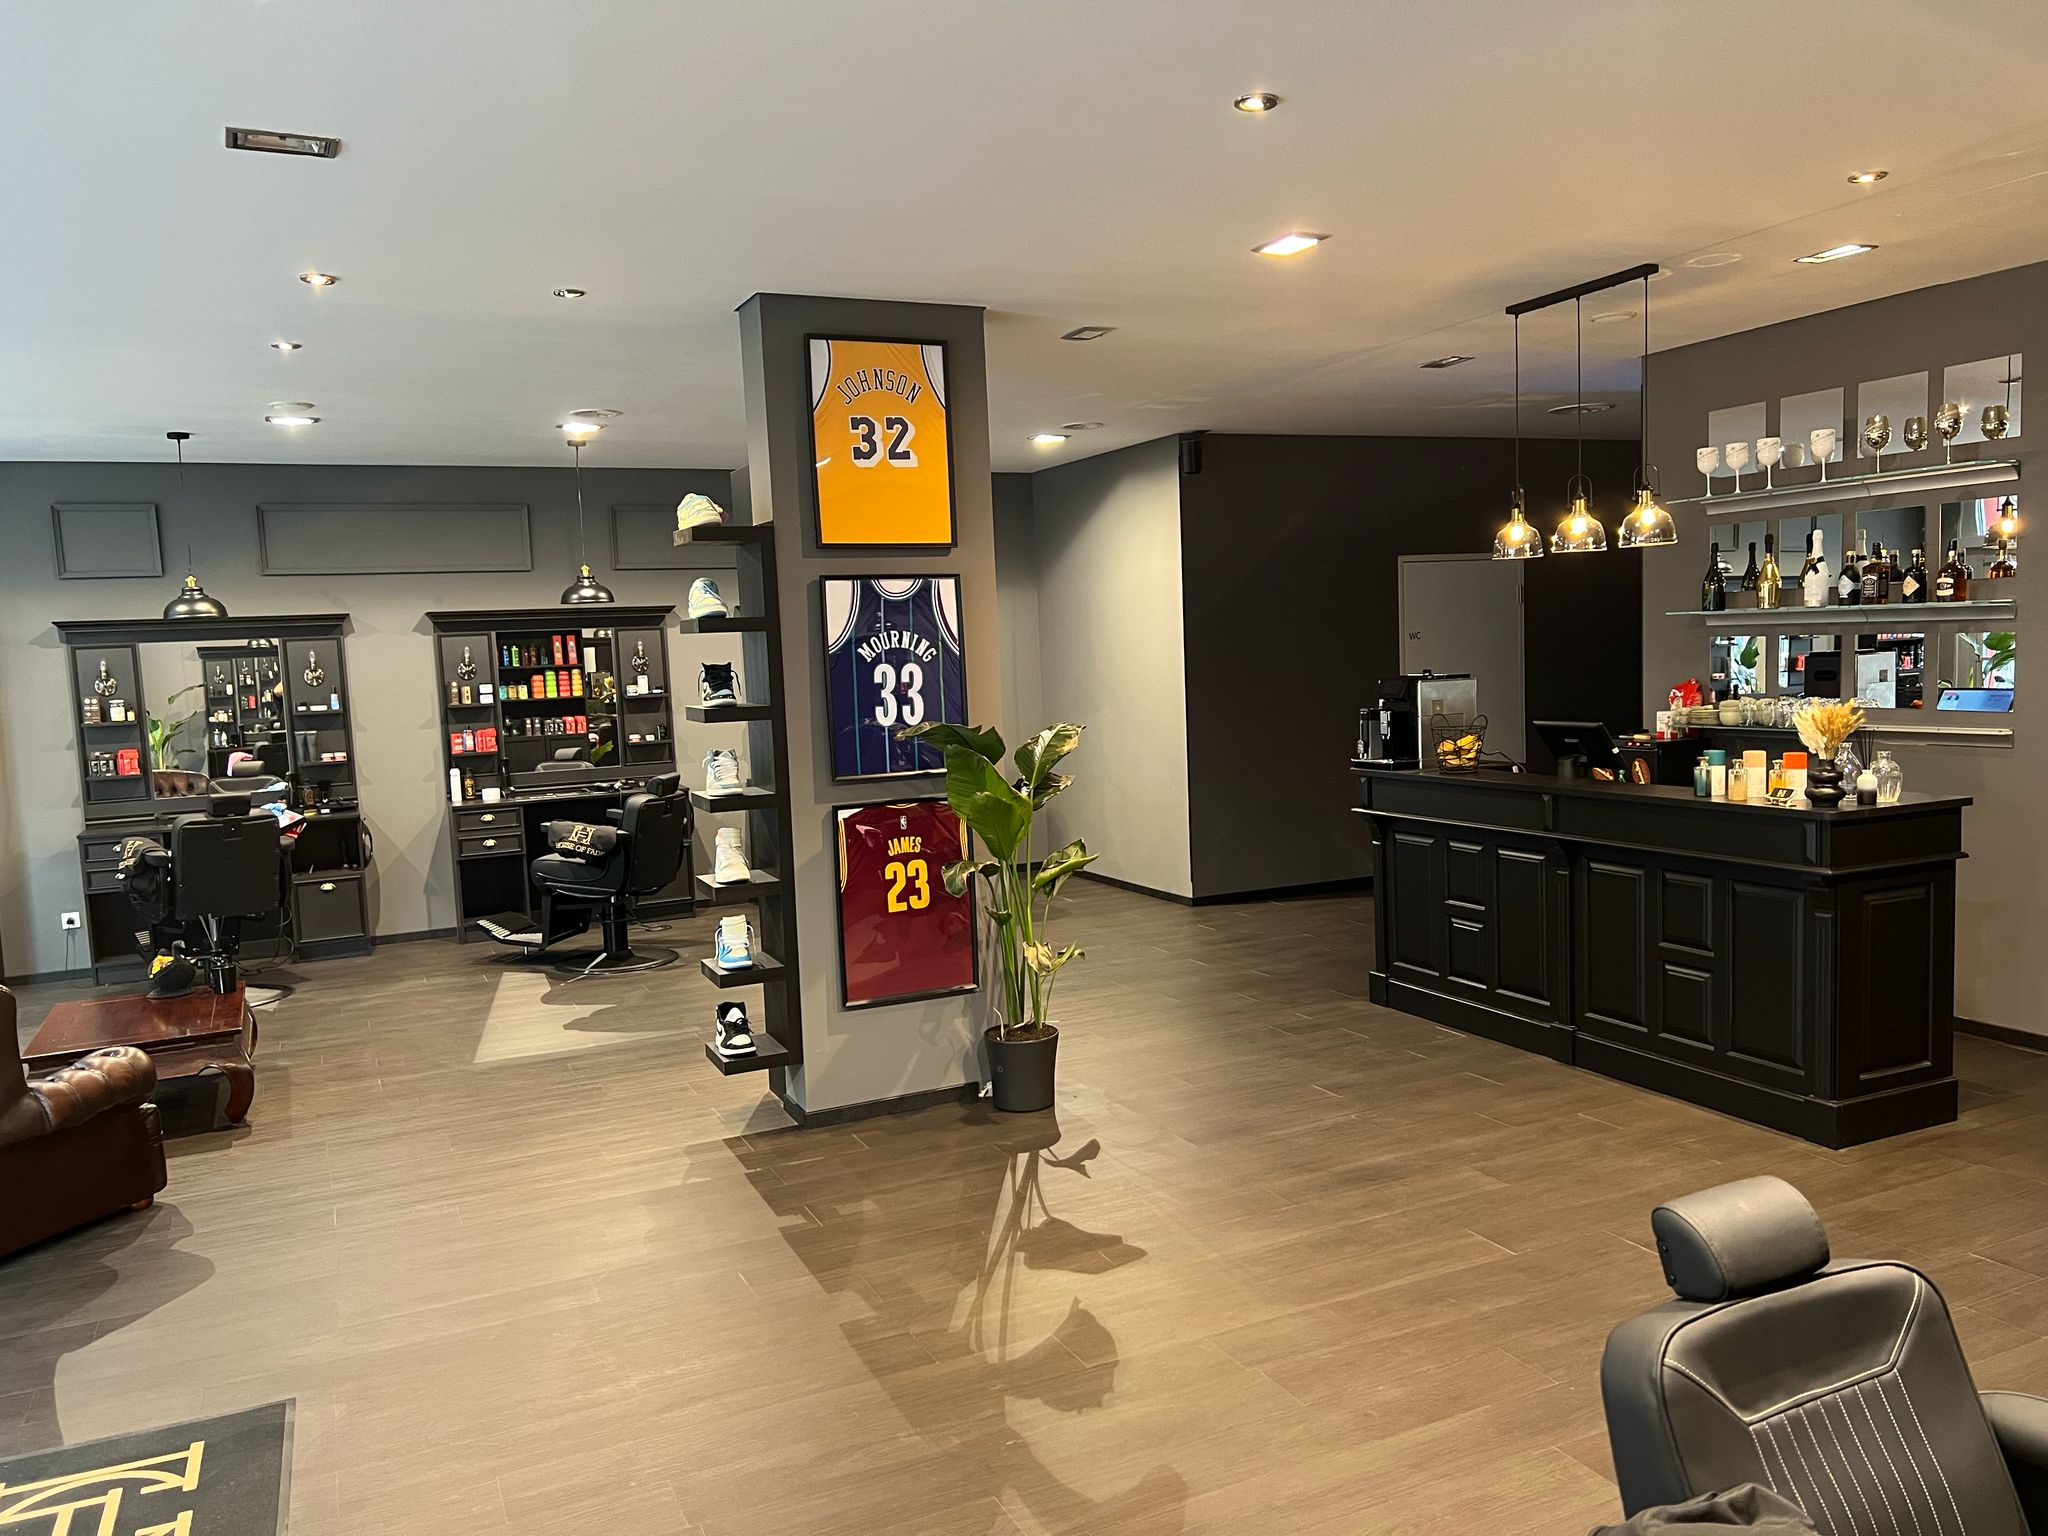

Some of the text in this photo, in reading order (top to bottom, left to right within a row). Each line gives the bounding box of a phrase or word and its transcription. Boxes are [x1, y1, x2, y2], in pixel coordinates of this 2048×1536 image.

[836, 368, 922, 405] JOHNSON
[849, 415, 918, 468] 32
[857, 630, 937, 663] MOURNING
[1409, 632, 1422, 640] WC
[873, 663, 925, 727] 33
[575, 844, 587, 853] OF
[887, 836, 922, 856] JAMES
[884, 858, 930, 913] 23
